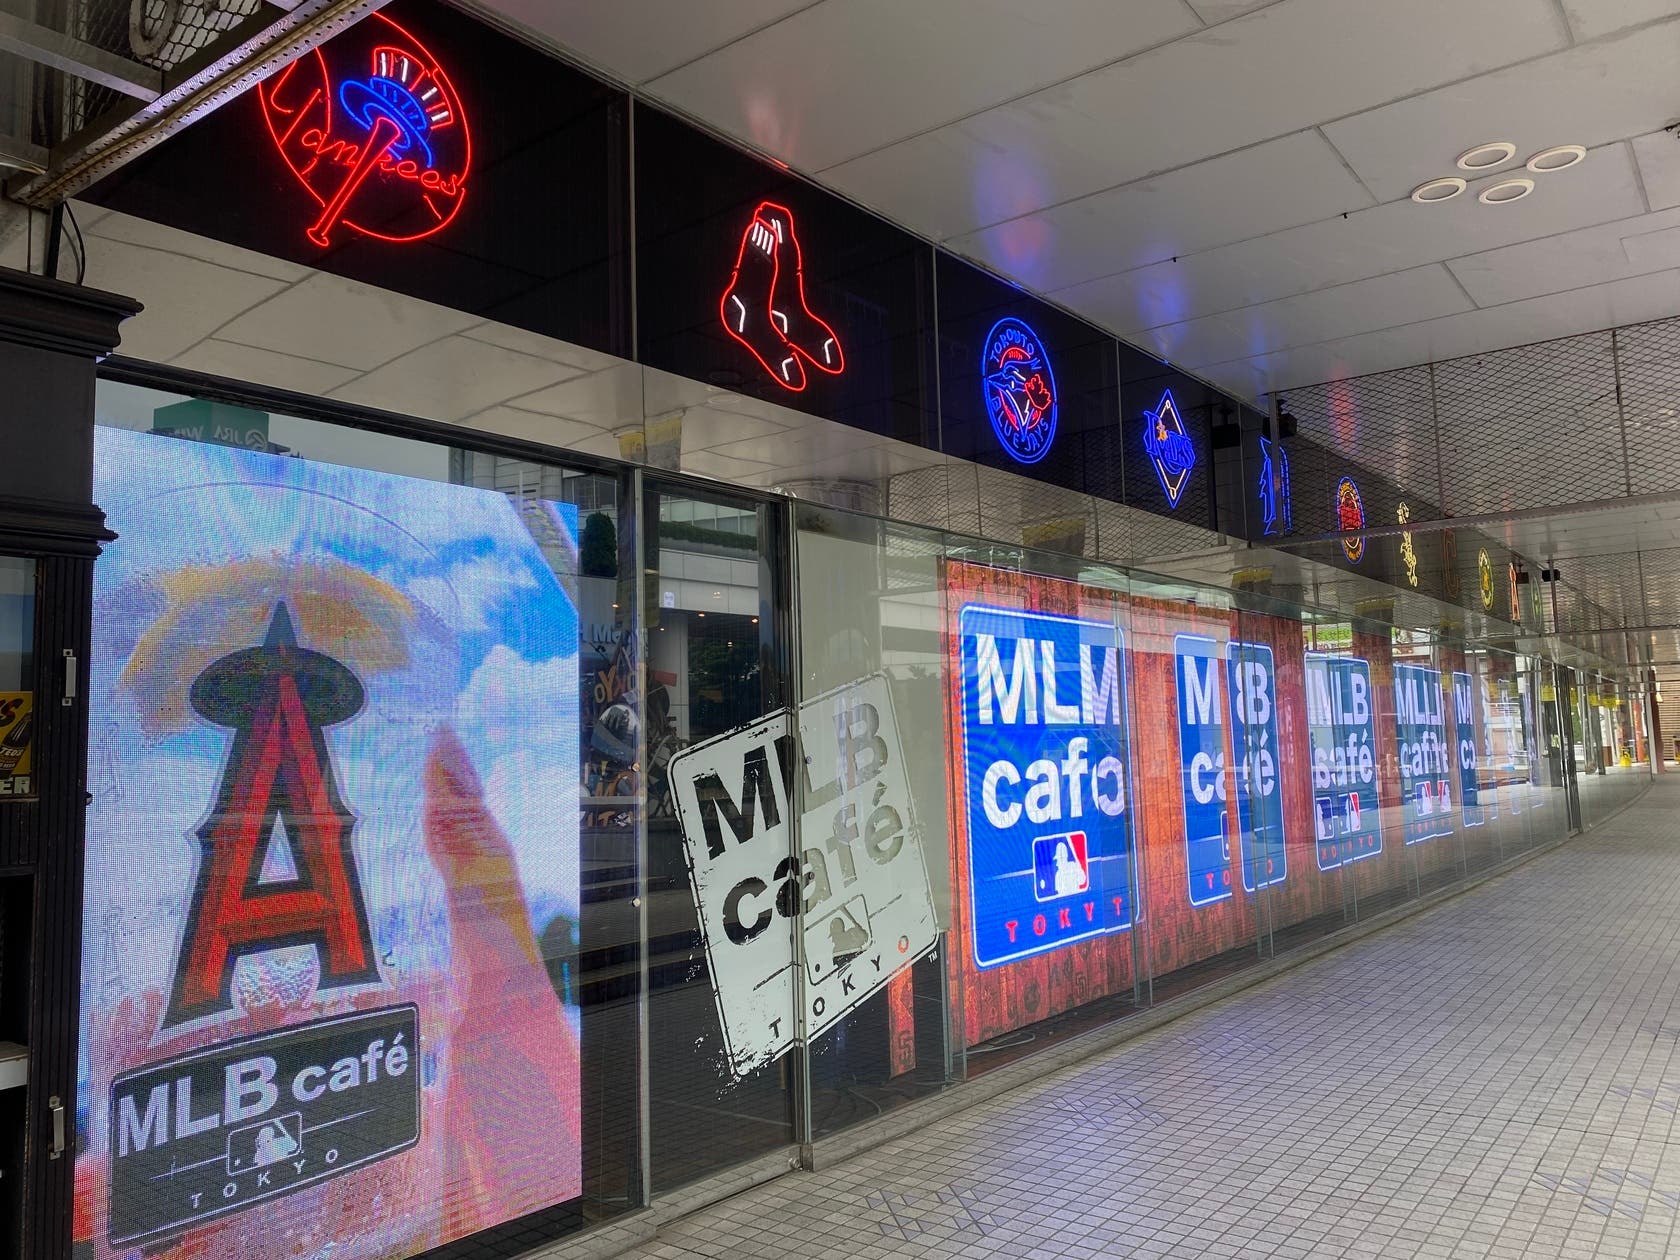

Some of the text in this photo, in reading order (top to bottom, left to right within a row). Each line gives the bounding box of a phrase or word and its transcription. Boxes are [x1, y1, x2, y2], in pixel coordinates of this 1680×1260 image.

[990, 328, 1043, 371] TORONTO
[992, 396, 1049, 452] BLUE JAYS
[693, 703, 889, 860] MLB
[722, 780, 904, 946] café
[768, 935, 910, 1040] TOKYO
[118, 1032, 409, 1157] MLB café
[190, 1149, 339, 1209] TOKYO
